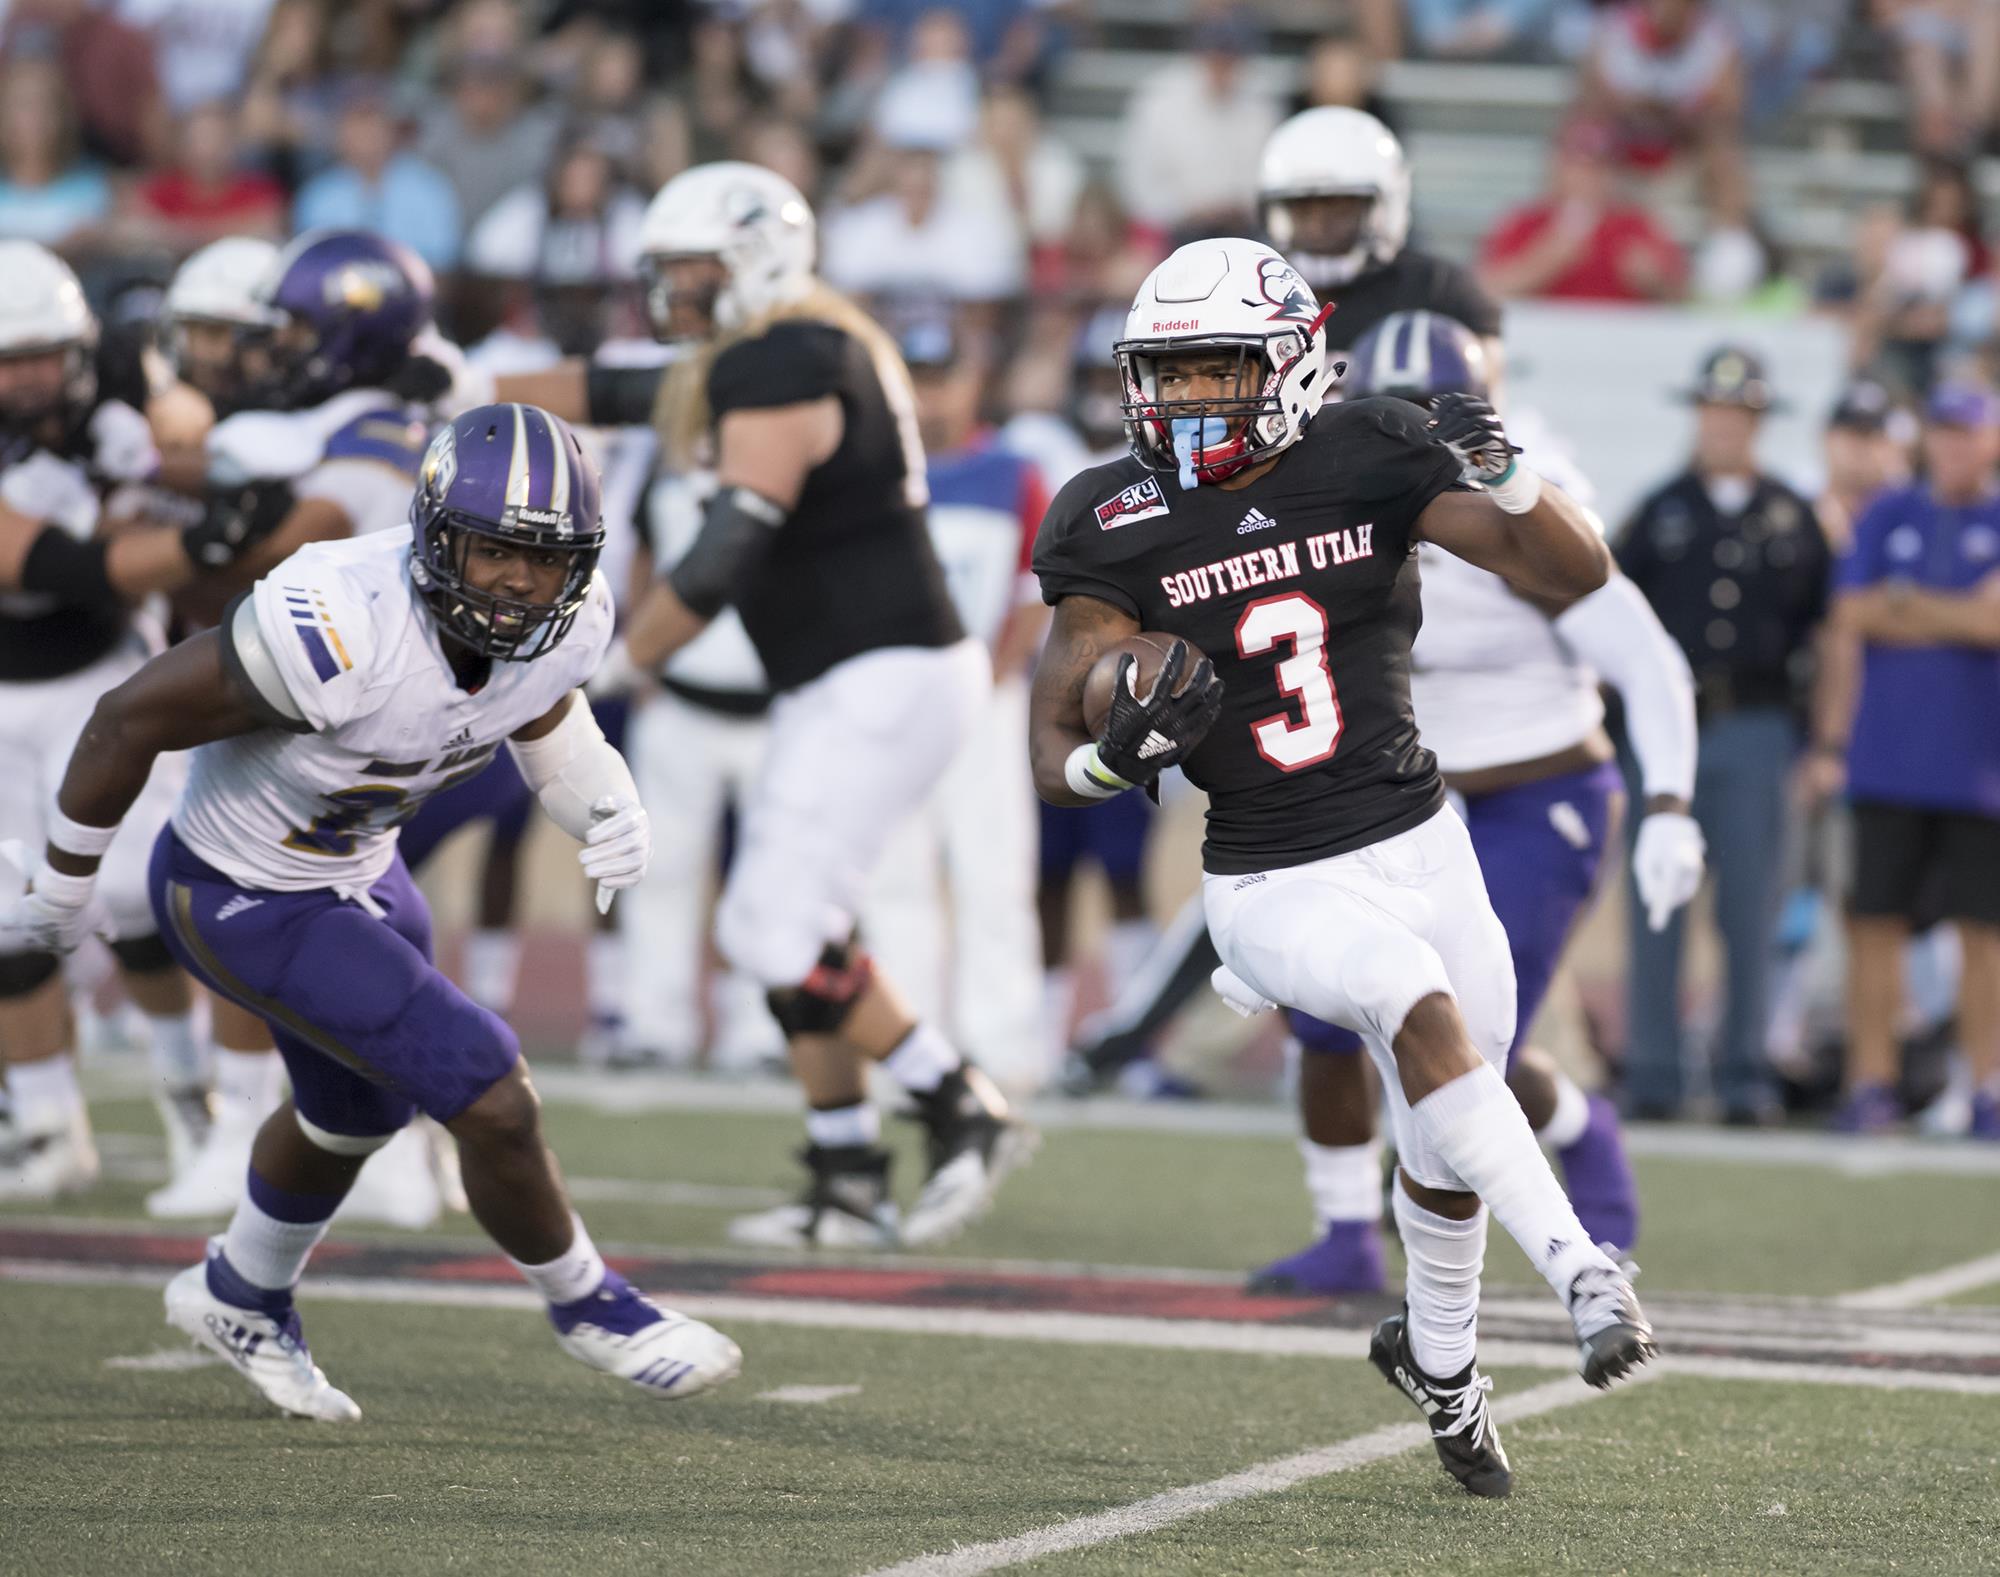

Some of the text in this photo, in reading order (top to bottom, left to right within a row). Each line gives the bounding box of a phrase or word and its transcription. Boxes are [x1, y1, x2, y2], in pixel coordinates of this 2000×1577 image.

[1152, 319, 1199, 333] Riddell
[518, 508, 558, 524] Riddell
[1236, 518, 1277, 535] adidas
[1160, 523, 1374, 608] SOUTHERN UTAH
[1234, 591, 1345, 772] 3
